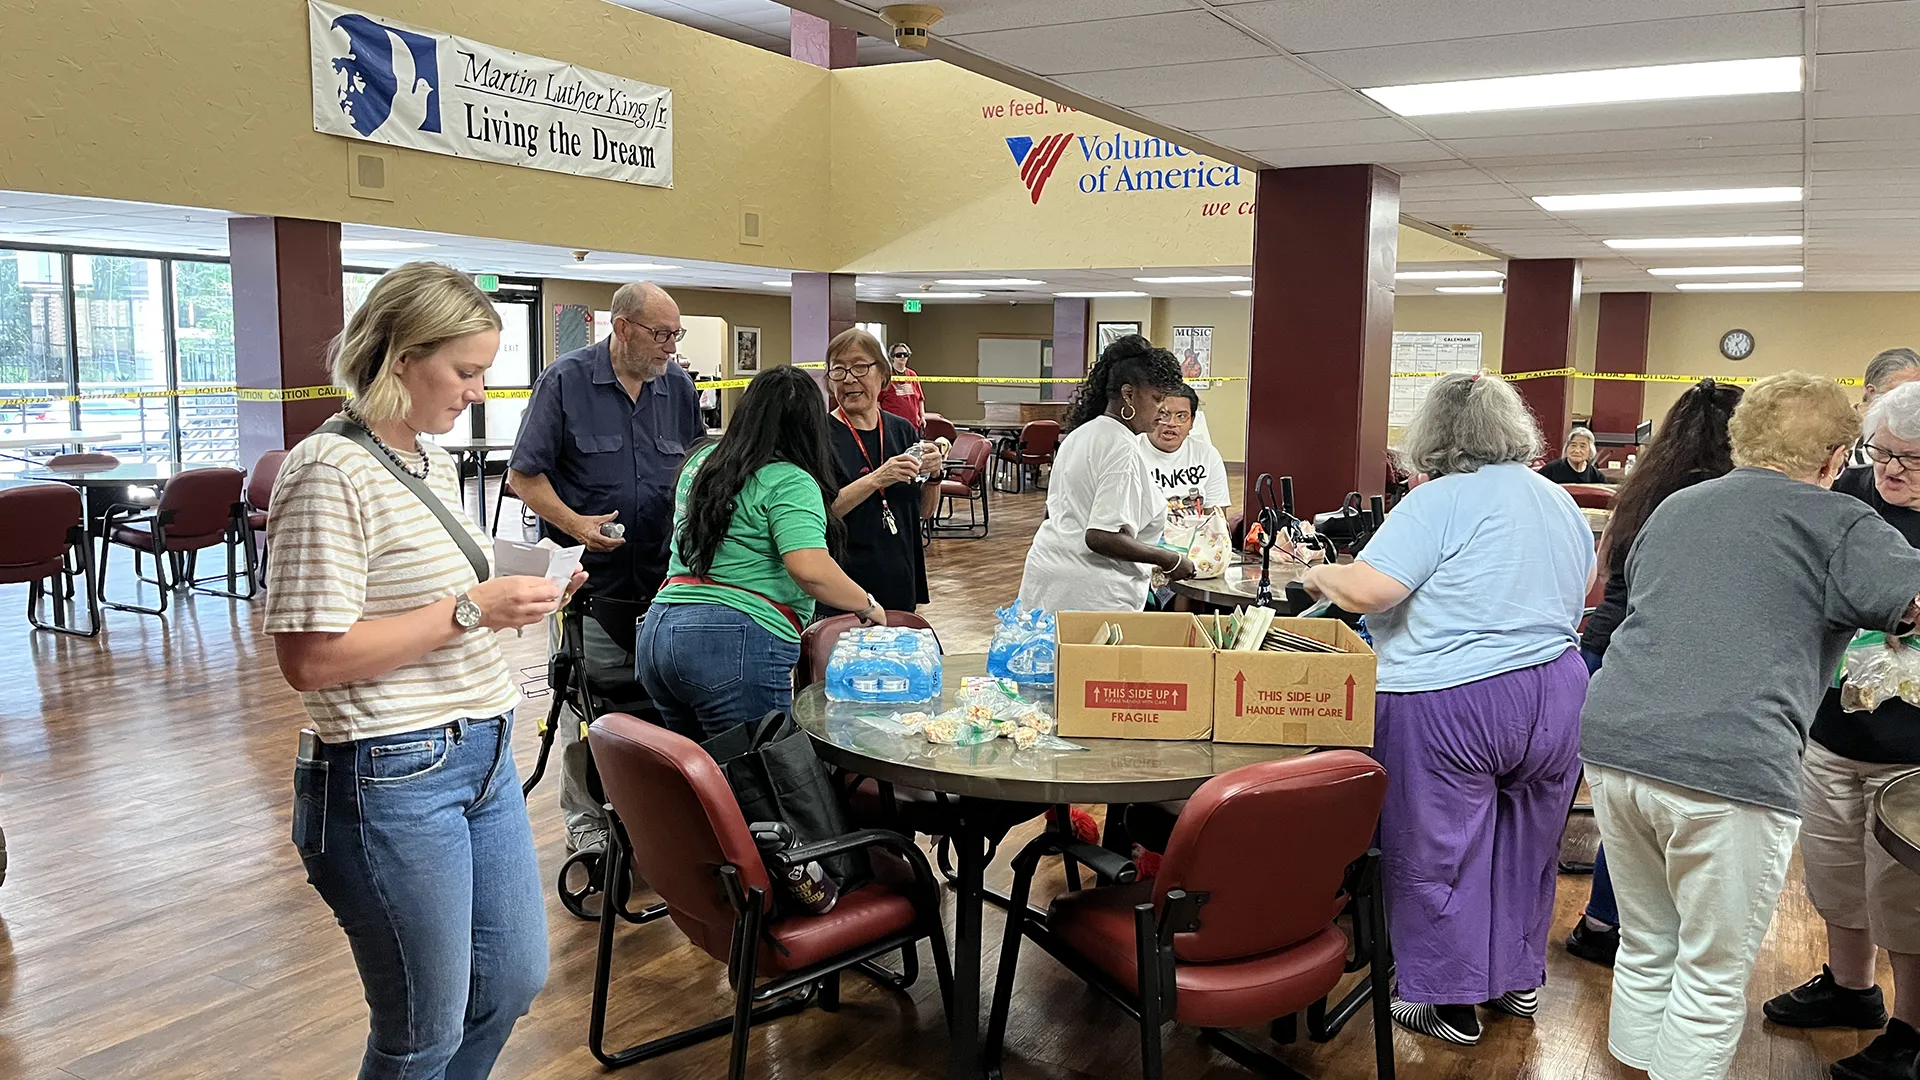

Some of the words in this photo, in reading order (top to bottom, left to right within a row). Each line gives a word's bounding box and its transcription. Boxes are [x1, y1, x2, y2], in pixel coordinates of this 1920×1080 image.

[456, 50, 538, 98] Martin
[544, 72, 604, 115] Luther
[606, 87, 650, 128] King,
[650, 97, 667, 129] Jr.
[982, 104, 1004, 118] we
[1009, 97, 1048, 116] feed.
[463, 102, 539, 157] Living
[549, 121, 582, 157] the
[592, 127, 656, 169] Dream
[1077, 132, 1204, 162] Volunte
[1079, 164, 1112, 194] of
[1113, 160, 1242, 192] America
[1202, 201, 1231, 217] we
[1175, 328, 1211, 337] MUSIC
[503, 344, 519, 352] EXIT
[268, 388, 310, 400] CAUTION
[1103, 687, 1126, 699] THIS
[1128, 688, 1153, 700] SIDE
[1155, 690, 1170, 700] UP
[1258, 690, 1282, 701] THIS
[1286, 691, 1311, 702] SIDE
[1315, 693, 1331, 703] UP
[1111, 712, 1159, 723] FRAGILE
[1246, 705, 1286, 715] HANDLE
[1289, 707, 1315, 716] WITH
[1317, 708, 1343, 717] CARE
